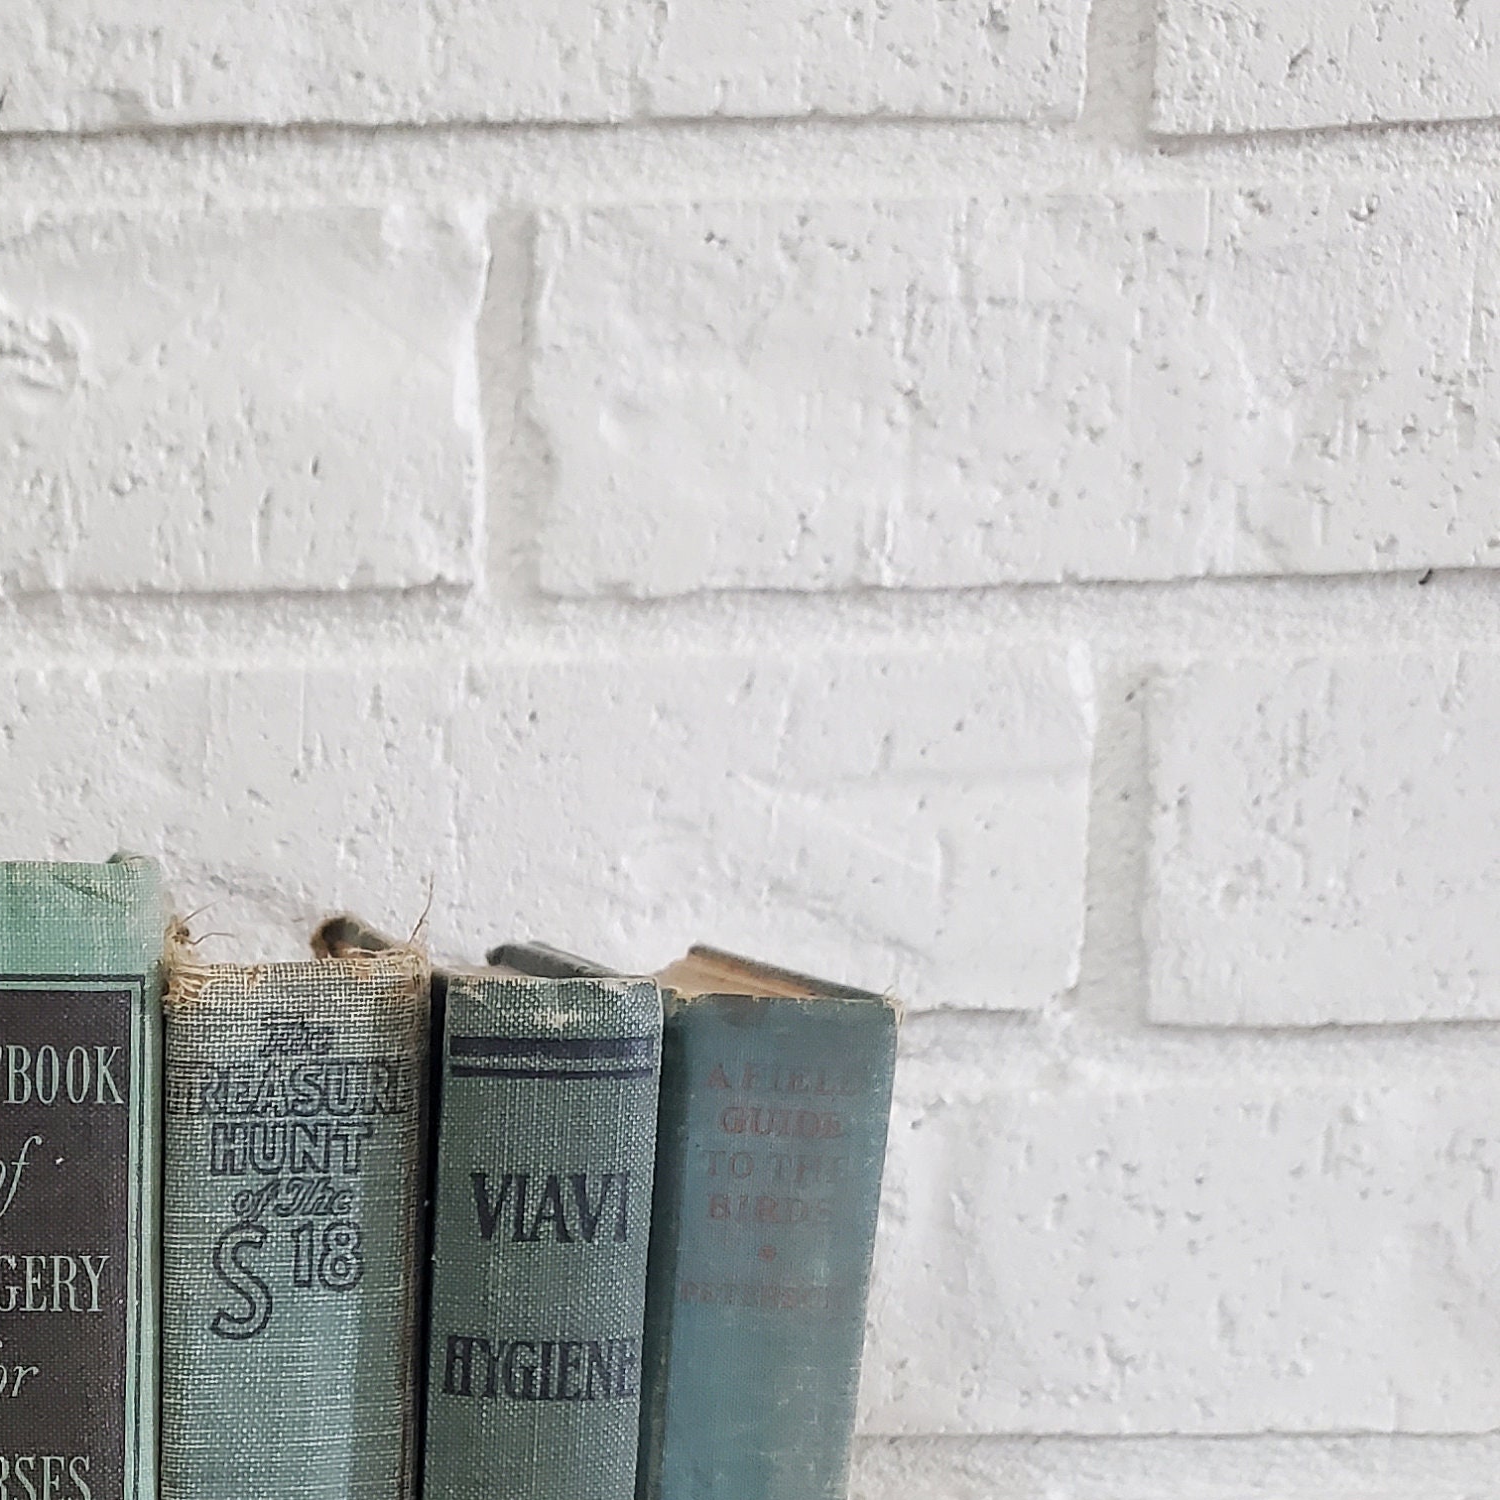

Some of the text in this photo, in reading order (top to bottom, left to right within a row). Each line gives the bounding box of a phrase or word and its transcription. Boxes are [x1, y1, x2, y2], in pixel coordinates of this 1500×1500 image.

[211, 1122, 373, 1175] HUNT
[721, 1106, 844, 1138] GUIDE
[707, 1151, 754, 1180] TO
[233, 1177, 351, 1220] of The
[470, 1173, 628, 1243] VIAVI
[208, 1220, 363, 1340] S 18
[442, 1335, 635, 1401] HYGIENE
